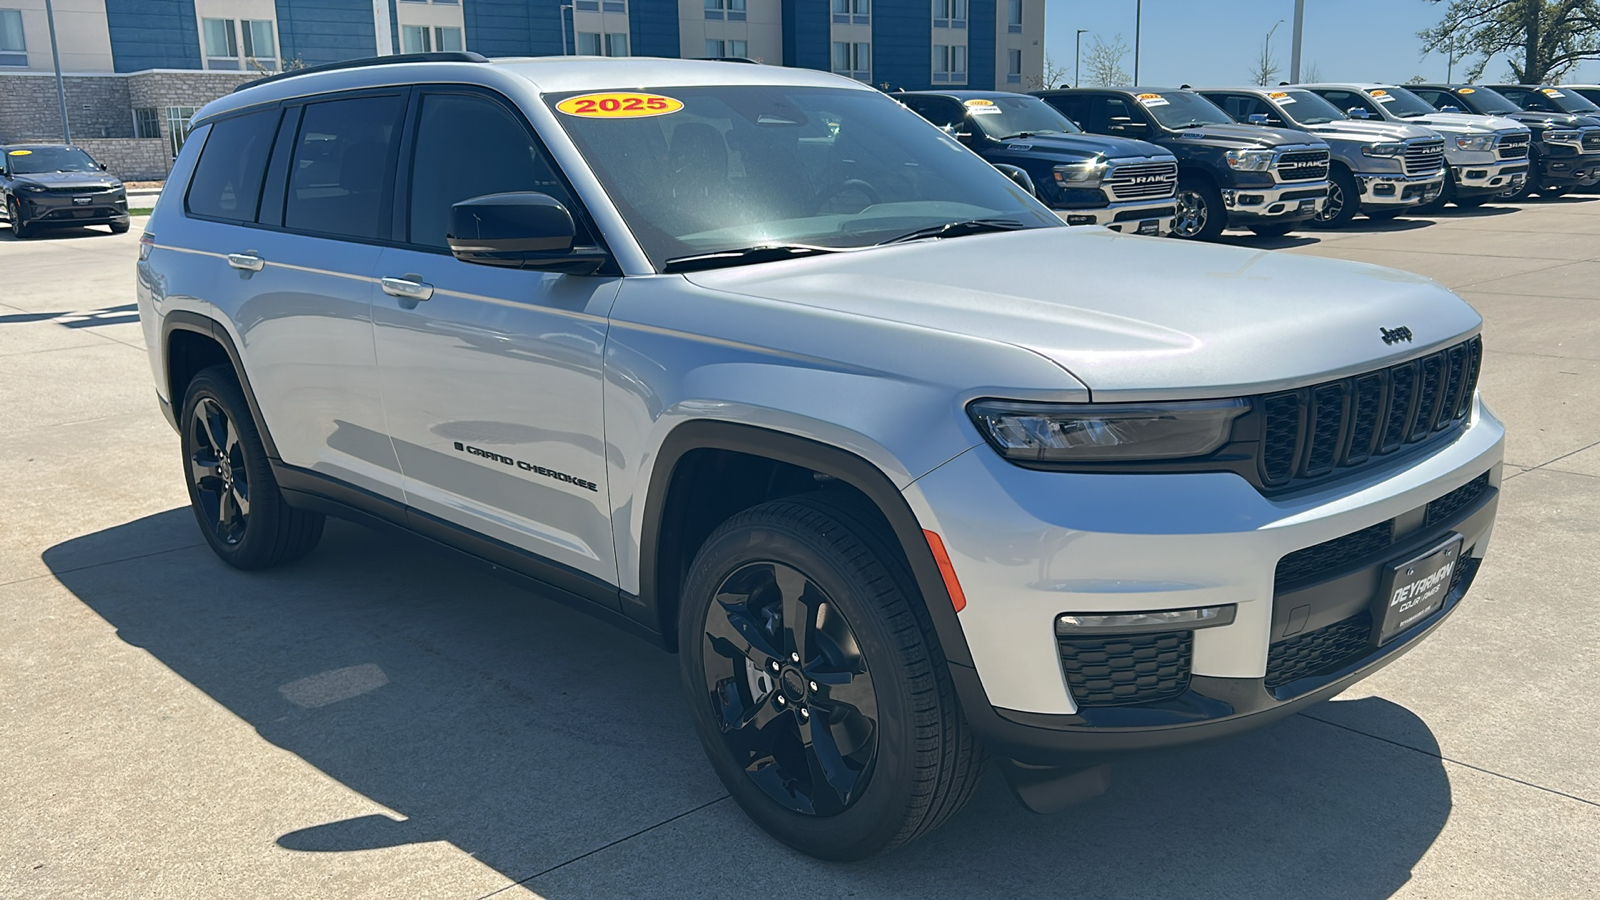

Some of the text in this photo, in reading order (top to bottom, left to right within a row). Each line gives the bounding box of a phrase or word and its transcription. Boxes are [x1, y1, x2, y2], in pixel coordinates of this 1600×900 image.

[574, 97, 668, 114] 2025
[1136, 175, 1165, 184] RAM
[1379, 325, 1413, 347] Jeep
[466, 445, 598, 493] GRAND CHEROKEE
[1390, 561, 1455, 607] DEYARMAN
